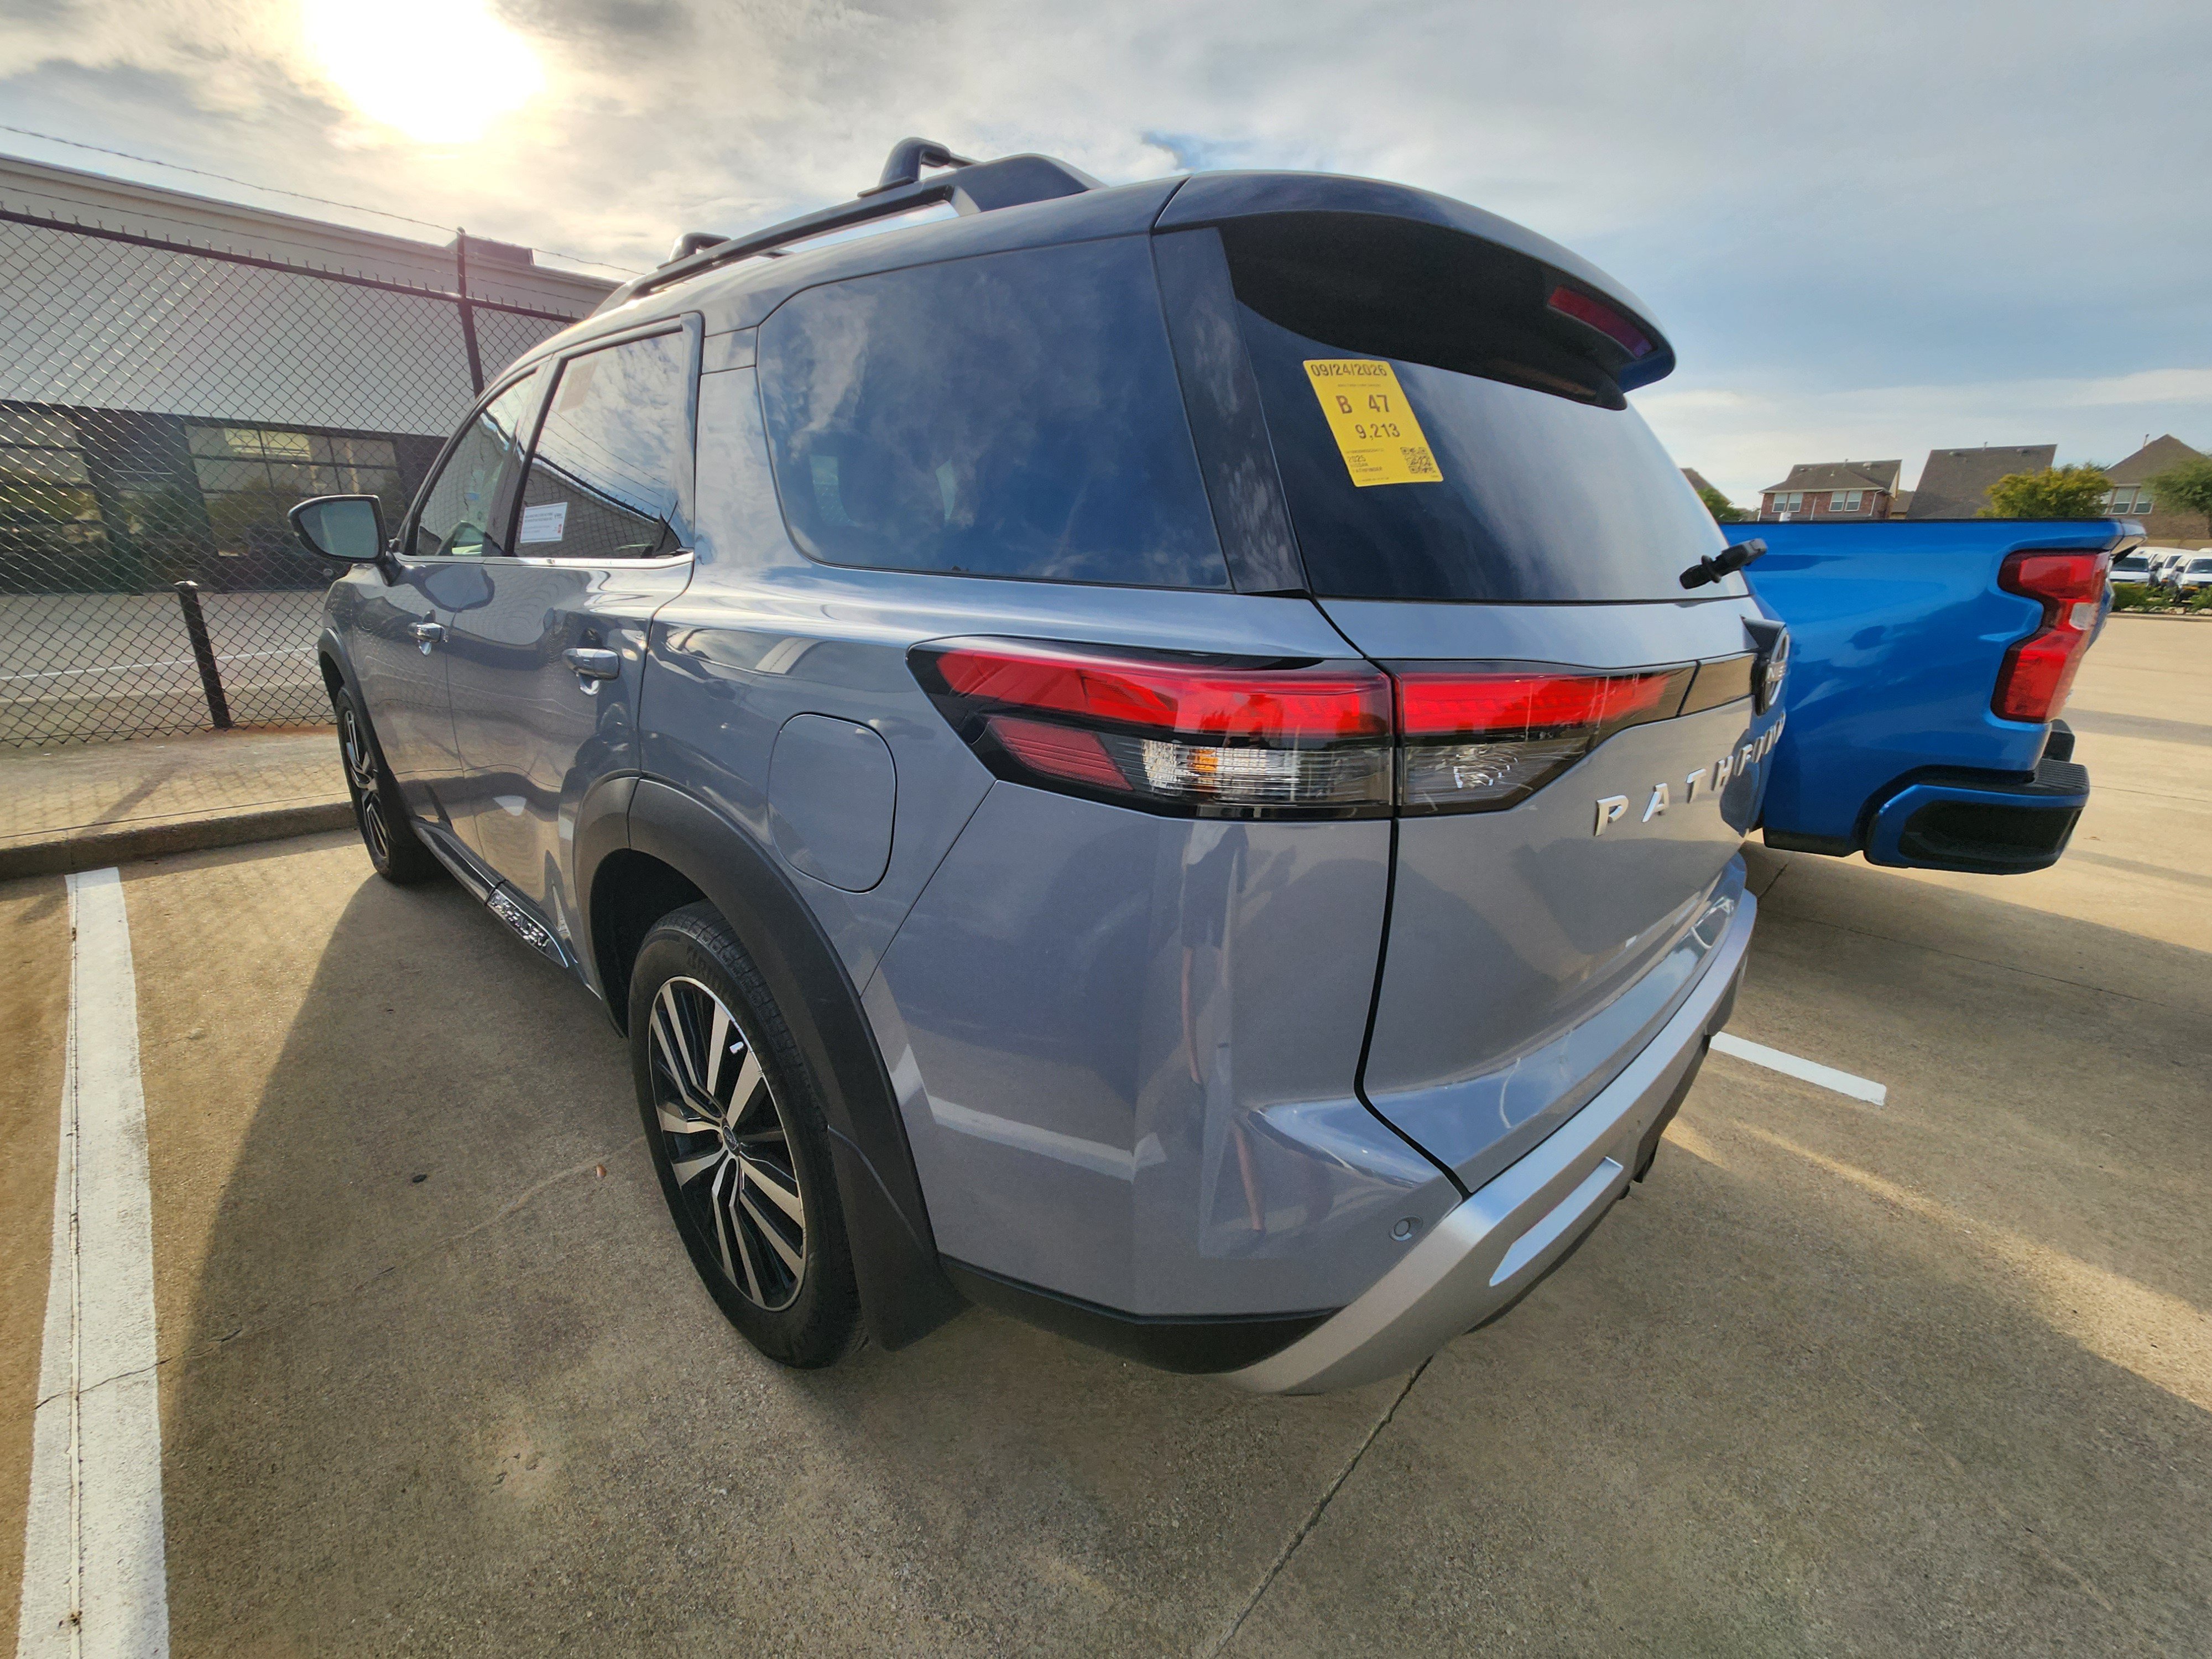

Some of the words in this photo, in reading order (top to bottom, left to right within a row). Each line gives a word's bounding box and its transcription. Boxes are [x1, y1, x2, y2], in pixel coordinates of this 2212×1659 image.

[1311, 363, 1387, 377] 09/24/2026
[1335, 395, 1353, 414] B
[1369, 394, 1390, 412] 47
[1355, 423, 1400, 440] 9,213
